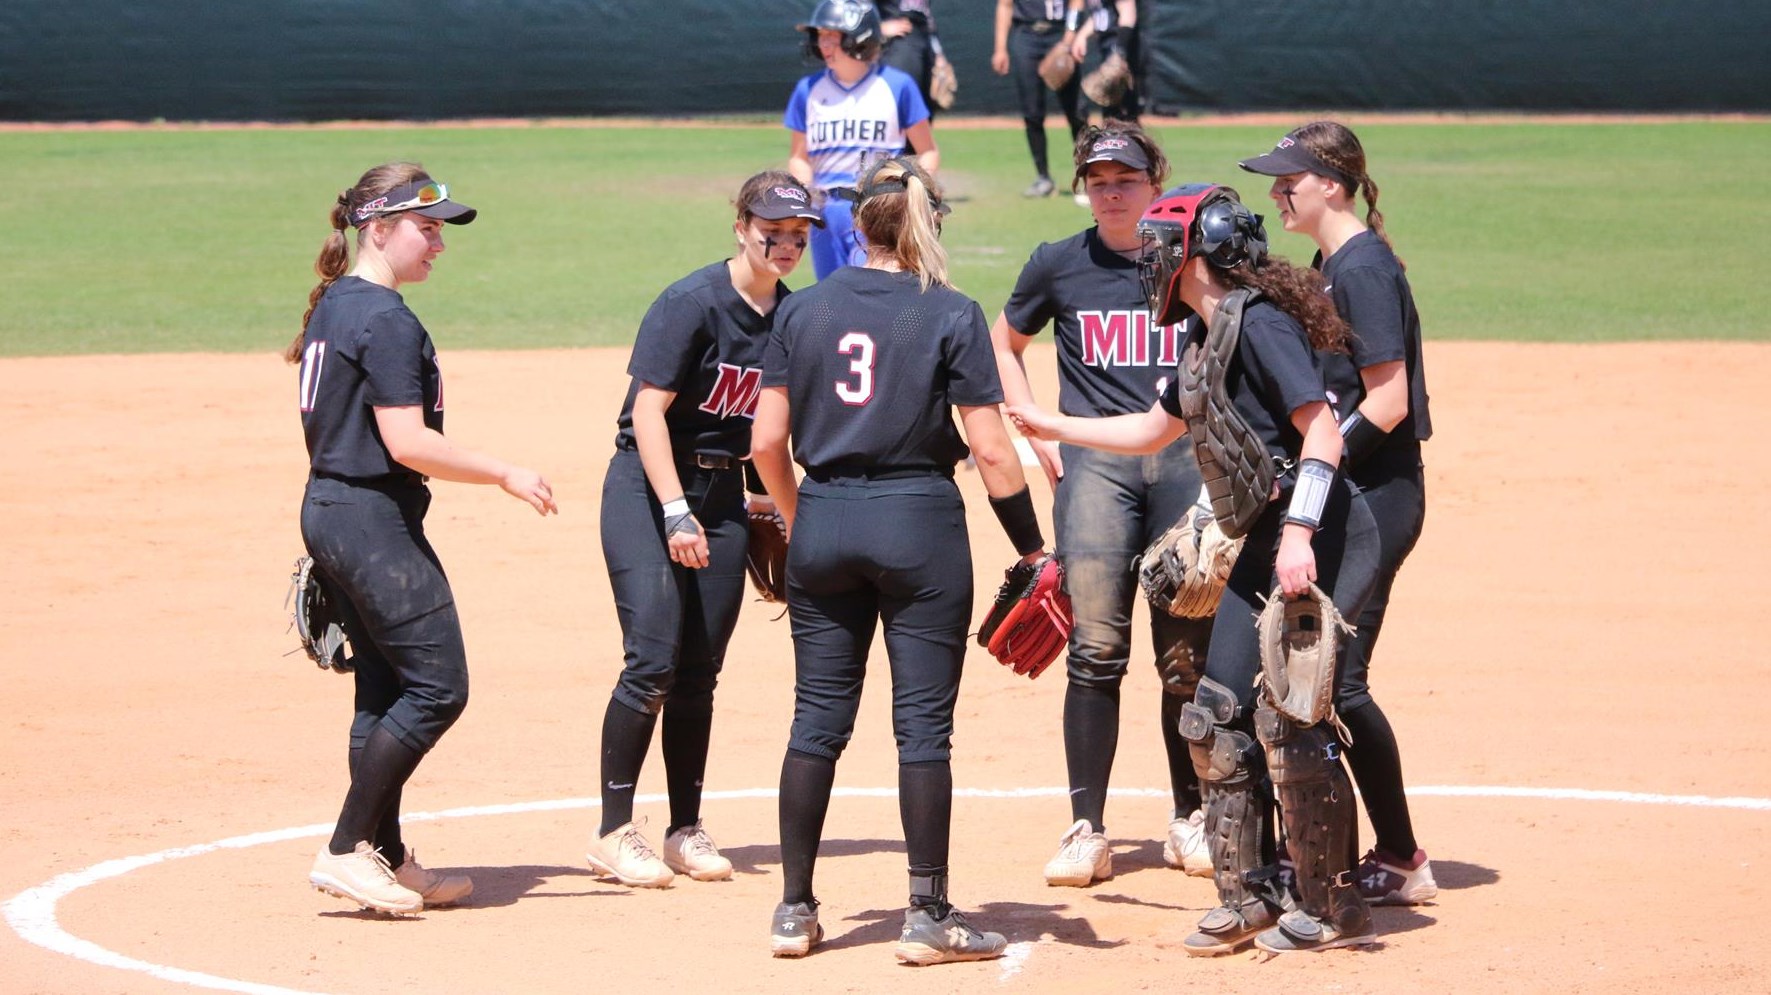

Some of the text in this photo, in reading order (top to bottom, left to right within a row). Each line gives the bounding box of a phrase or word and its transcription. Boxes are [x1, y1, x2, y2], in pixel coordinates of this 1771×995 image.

[300, 338, 326, 412] 11
[834, 330, 876, 406] 3
[1076, 309, 1187, 372] MIT
